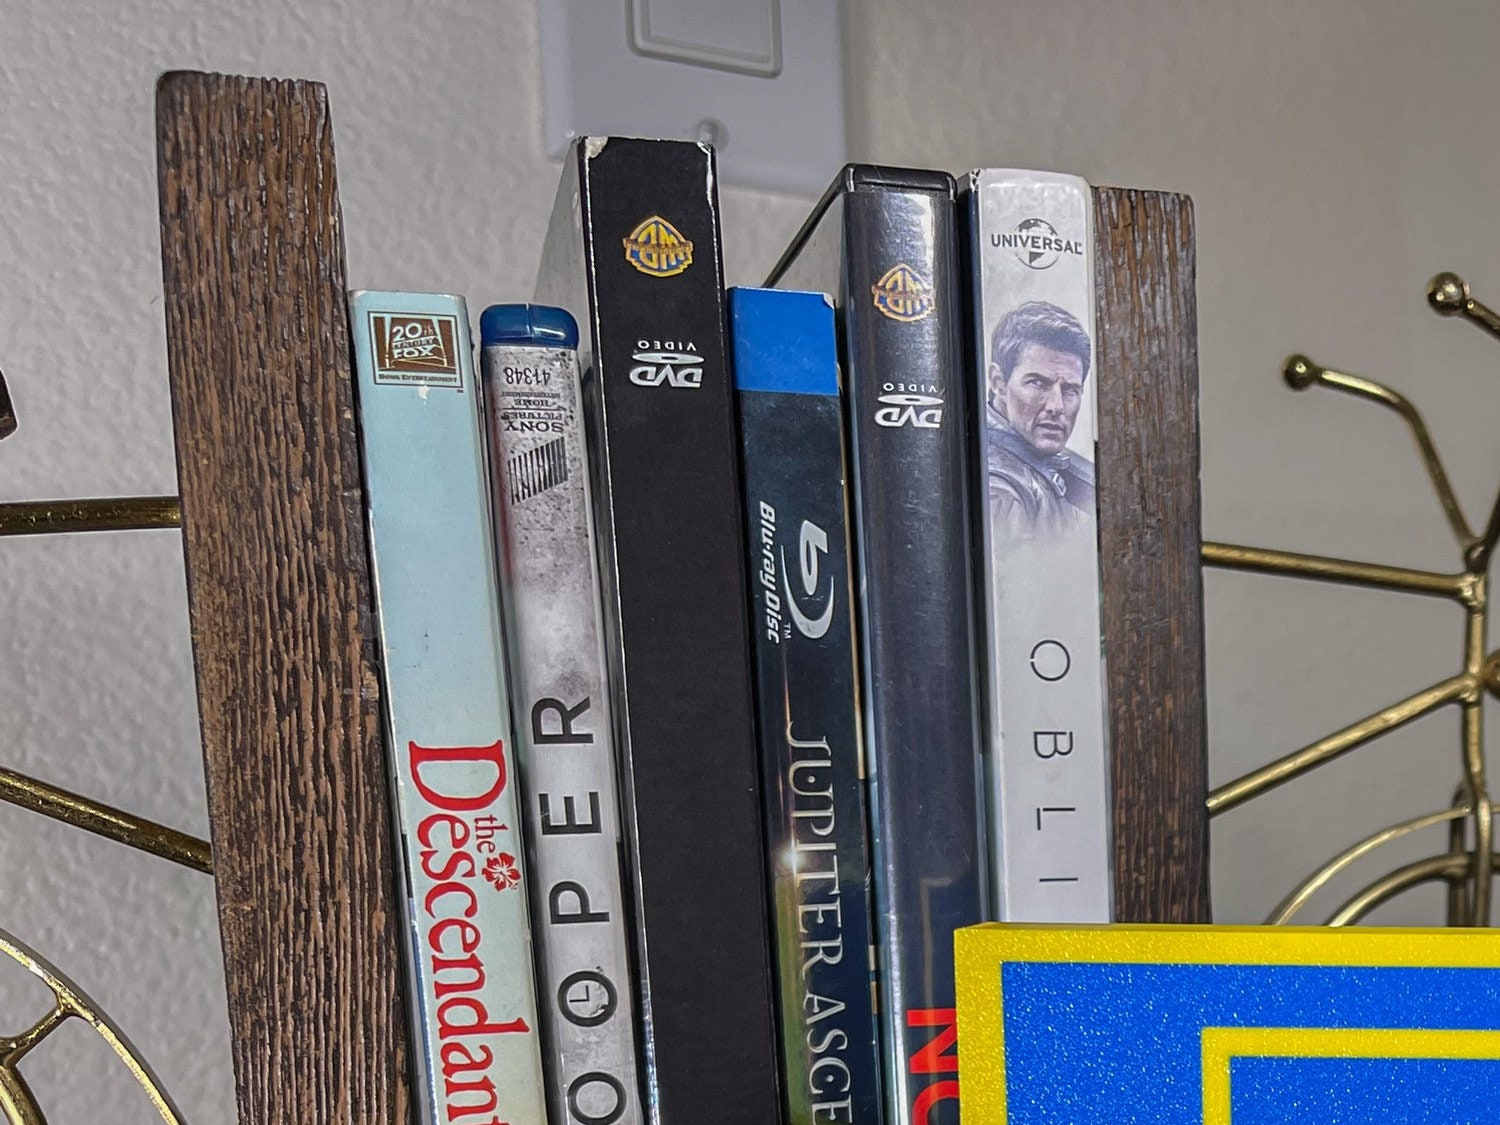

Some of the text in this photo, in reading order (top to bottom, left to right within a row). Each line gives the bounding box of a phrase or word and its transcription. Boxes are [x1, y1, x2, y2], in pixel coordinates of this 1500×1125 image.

[991, 233, 1083, 255] UNIVERSAL
[392, 322, 435, 341] 20th
[393, 346, 434, 359] FOX
[637, 340, 697, 351] VIDEO
[629, 364, 703, 388] DVD
[883, 383, 937, 393] VIDEO
[514, 398, 553, 407] HOME
[502, 411, 563, 421] PICTURES
[875, 405, 943, 429] DVD
[504, 421, 564, 432] SONY
[759, 500, 783, 645] Blu-ray Disc
[473, 813, 508, 854] the
[786, 720, 845, 980] JUPITER
